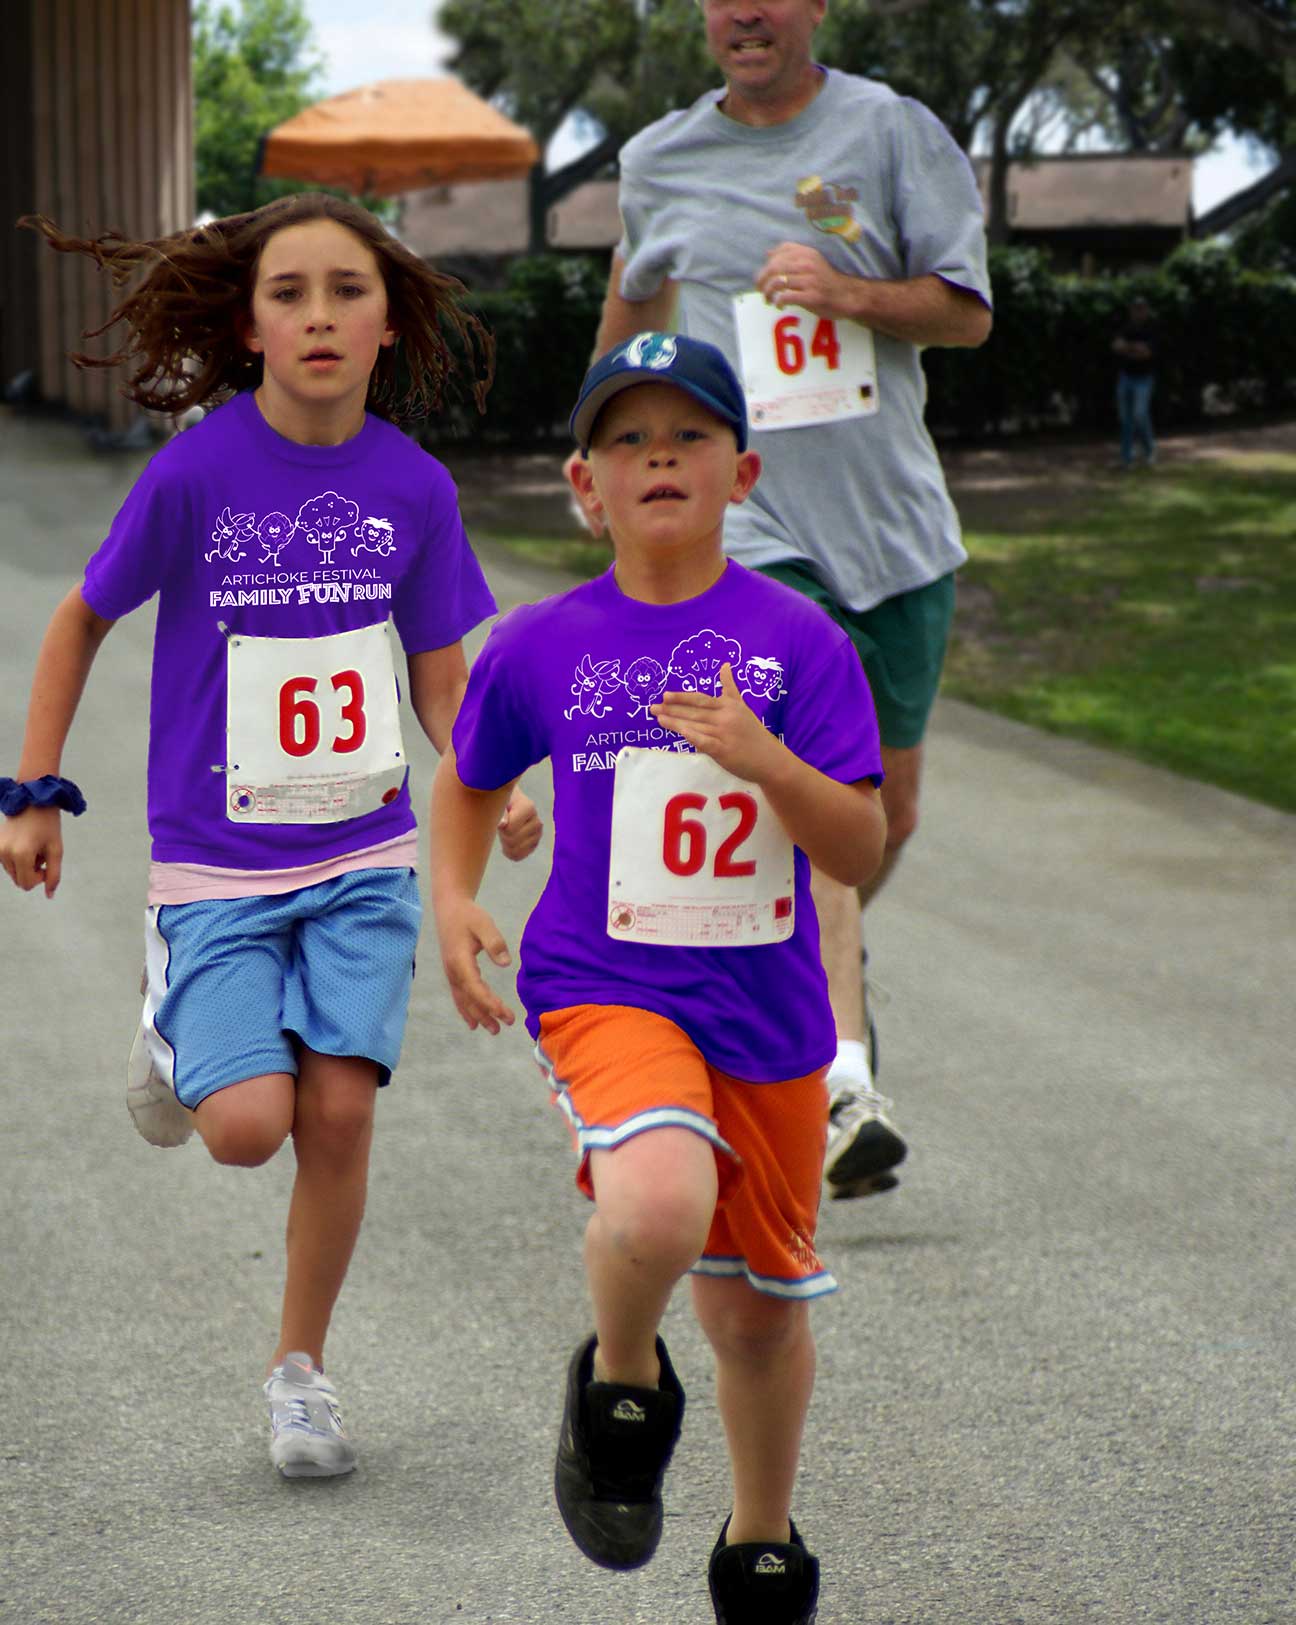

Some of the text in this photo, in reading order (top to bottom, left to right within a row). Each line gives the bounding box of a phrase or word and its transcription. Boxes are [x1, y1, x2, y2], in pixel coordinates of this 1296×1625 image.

[773, 315, 841, 376] 64
[209, 582, 392, 607] FAMILY FUN RUN
[221, 568, 381, 586] ARTICHOKE FESTIVAL
[279, 669, 367, 757] 63
[663, 792, 758, 878] 62
